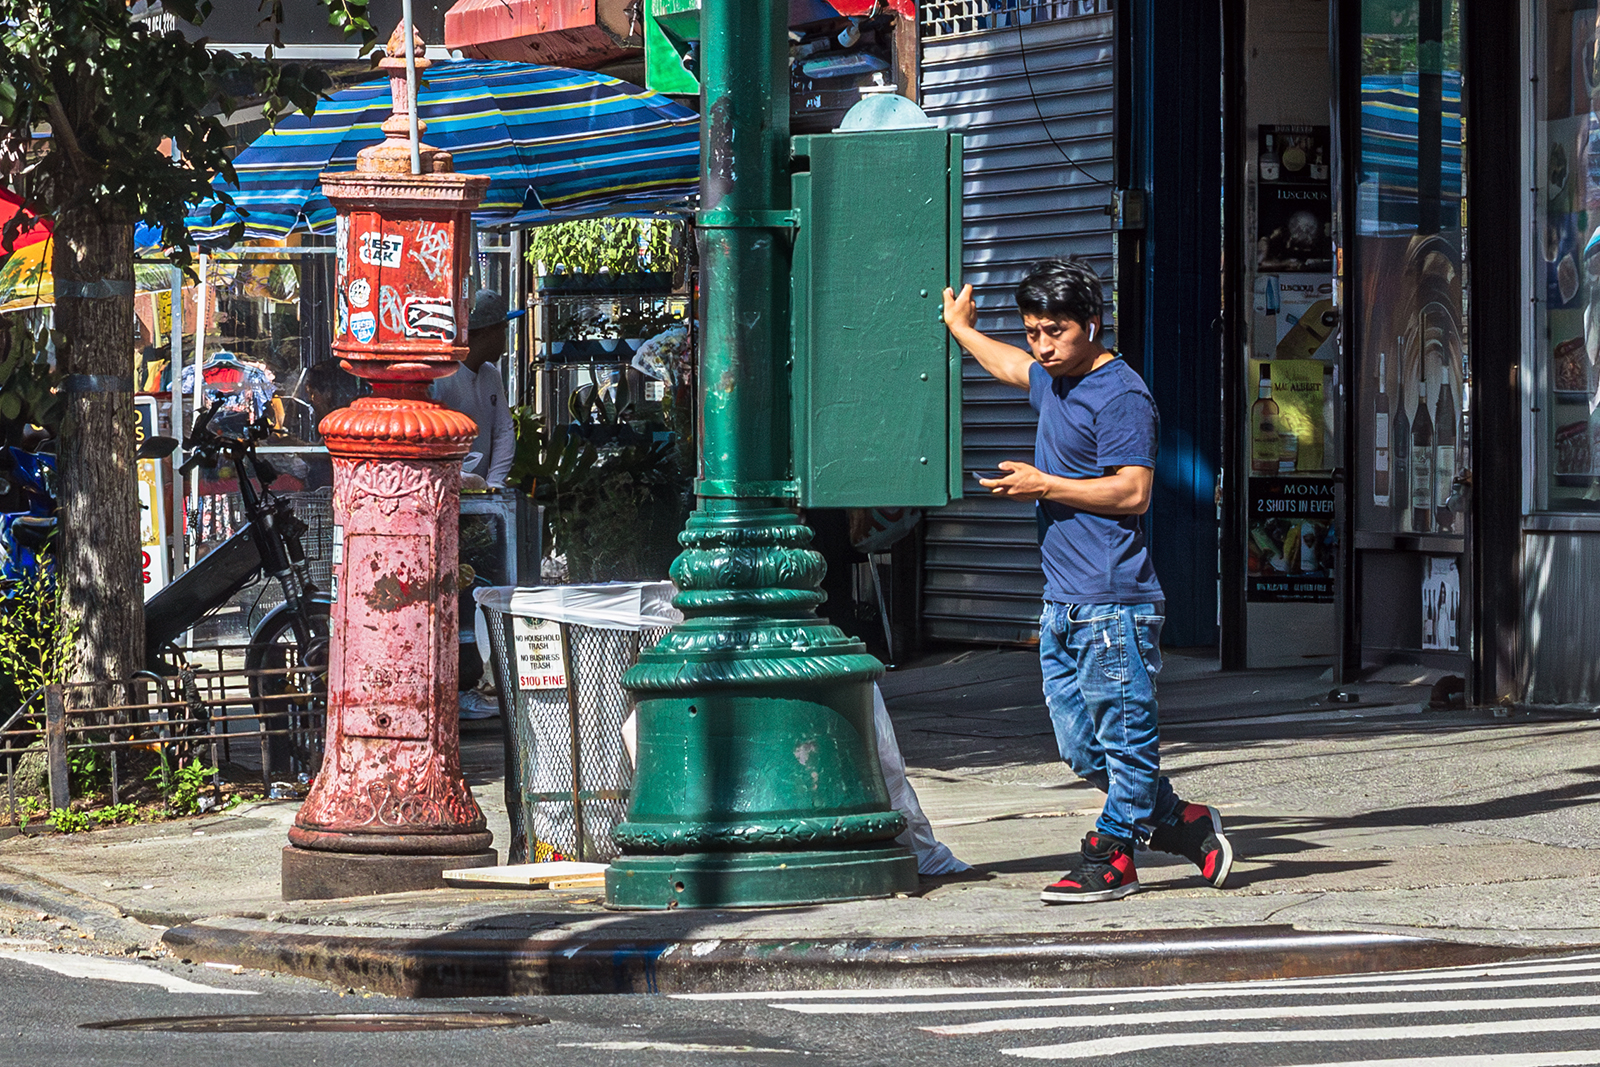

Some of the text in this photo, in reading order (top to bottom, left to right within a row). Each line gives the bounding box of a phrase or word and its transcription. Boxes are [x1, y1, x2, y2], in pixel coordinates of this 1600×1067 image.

[1277, 189, 1328, 200] LUSCIOUS
[1290, 383, 1322, 391] ALBERT
[1257, 499, 1264, 512] 2
[1266, 499, 1297, 512] SHOTS
[1298, 500, 1308, 512] IN
[524, 634, 560, 642] HOUSEHOLD
[530, 662, 551, 670] TRASH
[520, 674, 565, 686] $100 FINE
